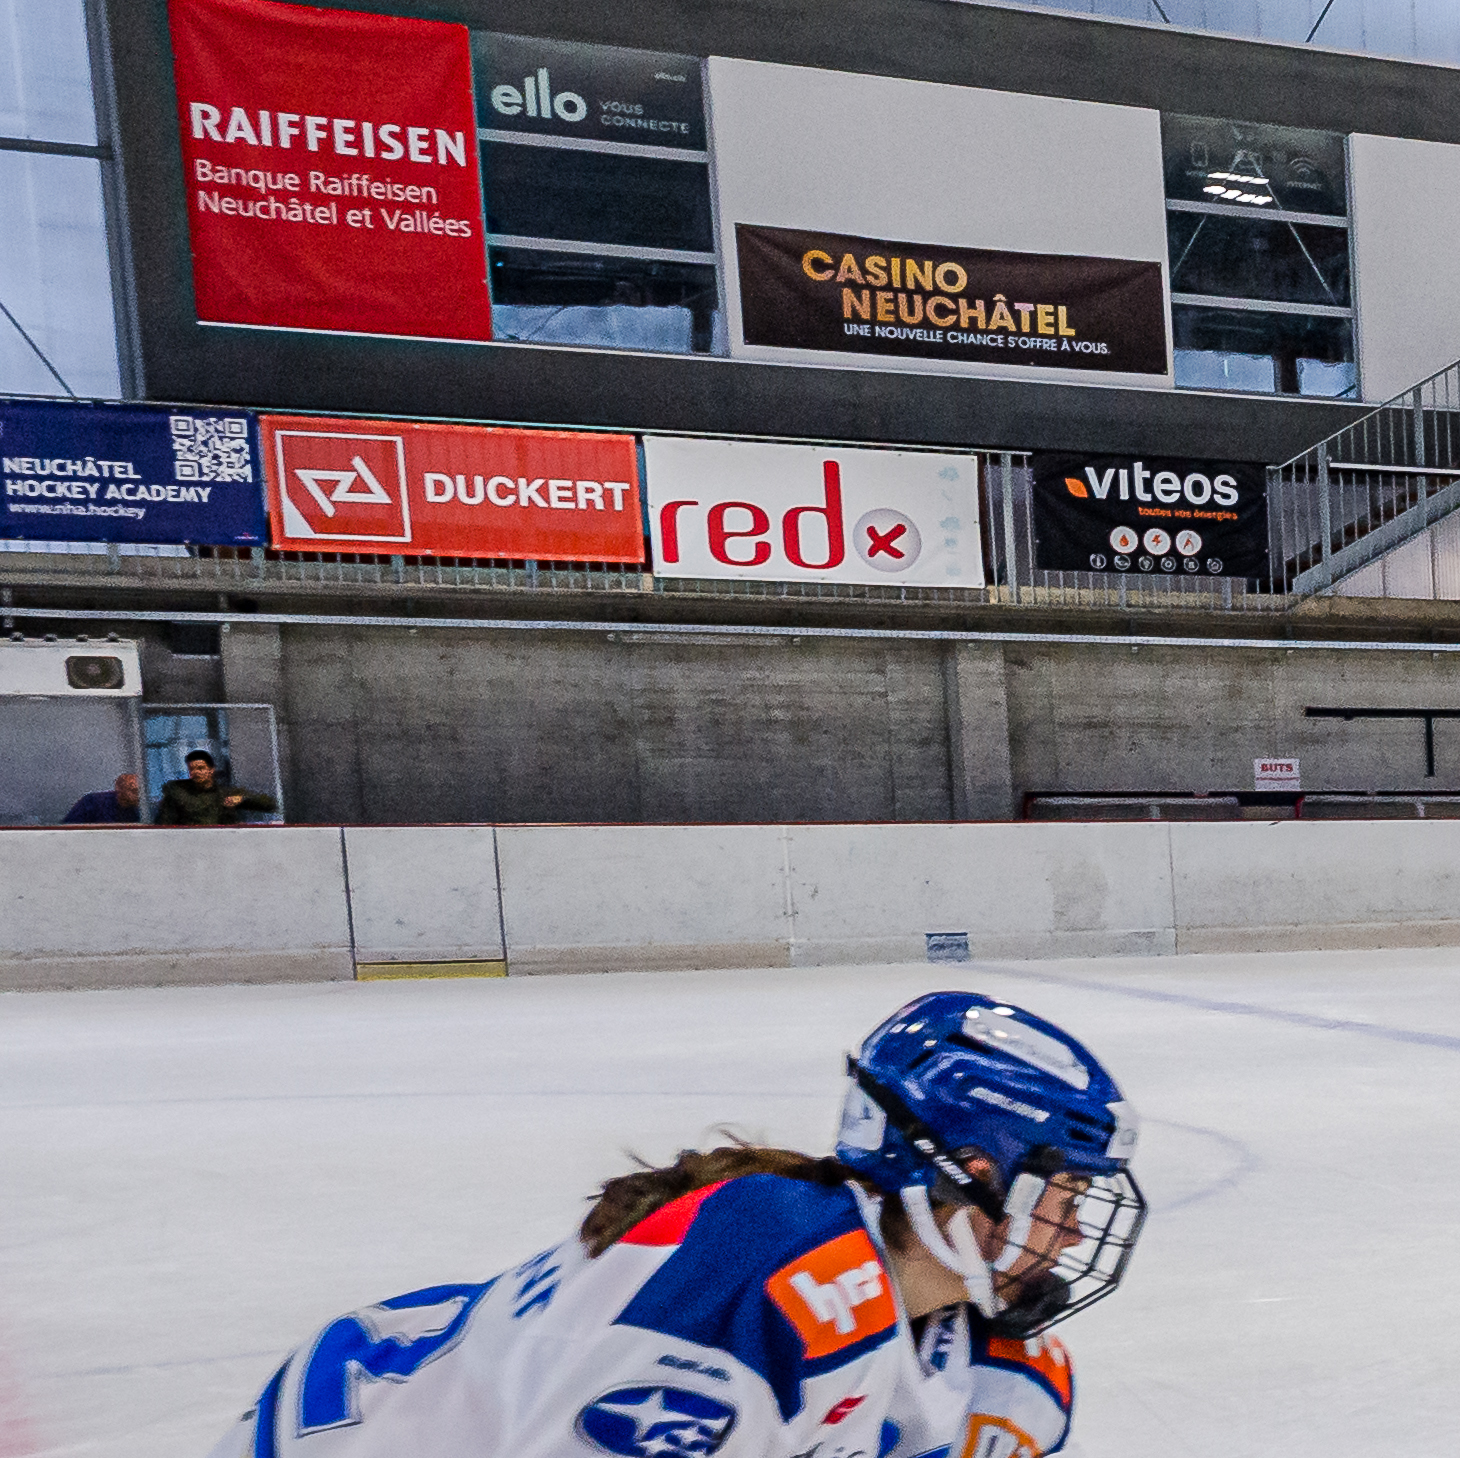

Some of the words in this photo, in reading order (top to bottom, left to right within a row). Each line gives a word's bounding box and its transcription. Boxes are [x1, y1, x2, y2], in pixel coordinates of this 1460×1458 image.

[491, 67, 588, 122] ello
[600, 100, 645, 115] VOUS
[190, 102, 467, 167] RAIFFEISEN
[600, 115, 691, 134] CONNECTE
[194, 159, 301, 193] Banque
[309, 171, 438, 204] Raiffeisen
[197, 191, 337, 225] Neuchâtel
[346, 206, 374, 229] et
[380, 208, 472, 238] Vallées
[802, 249, 968, 293] CASINO
[842, 288, 1076, 336] NEUCHÂTEL
[843, 323, 872, 337] UNE
[875, 325, 943, 343] NOUVELLE
[947, 331, 1004, 347] CHANCE
[1008, 335, 1057, 351] S'OFFRE
[1061, 335, 1070, 351] À
[2, 457, 142, 479] NEUCHÂTEL
[1085, 461, 1239, 506] viteos
[5, 480, 100, 499] HOCKEY
[104, 484, 212, 502] ACADEMY
[424, 471, 630, 512] DUCKERT
[659, 460, 846, 570] red
